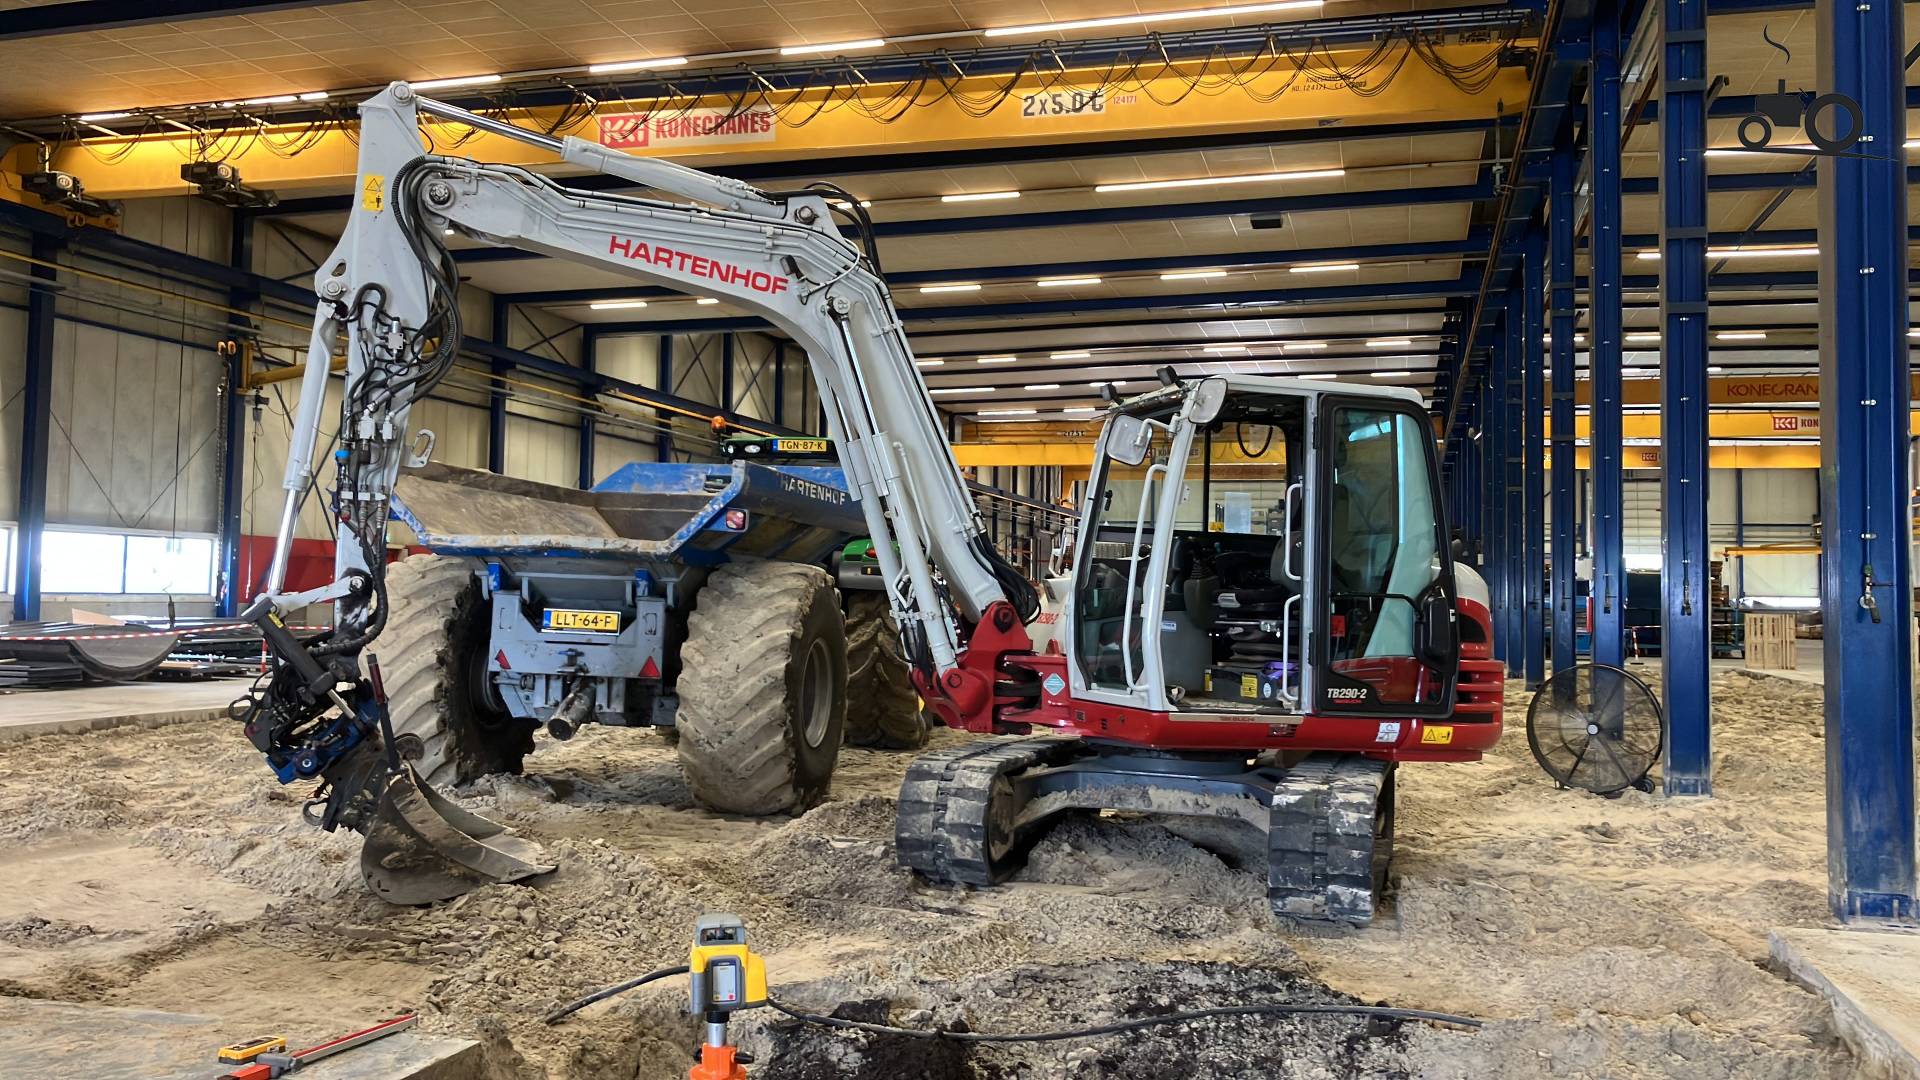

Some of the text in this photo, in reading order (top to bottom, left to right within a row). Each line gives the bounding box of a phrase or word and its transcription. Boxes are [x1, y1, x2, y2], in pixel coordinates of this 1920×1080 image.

[1114, 95, 1137, 105] 124171
[655, 112, 771, 139] KONECRANES
[609, 235, 789, 294] HARTENHOF
[780, 440, 823, 450] TGN-87-K
[556, 613, 612, 627] LLT-64-F
[1327, 688, 1368, 699] TB290-2
